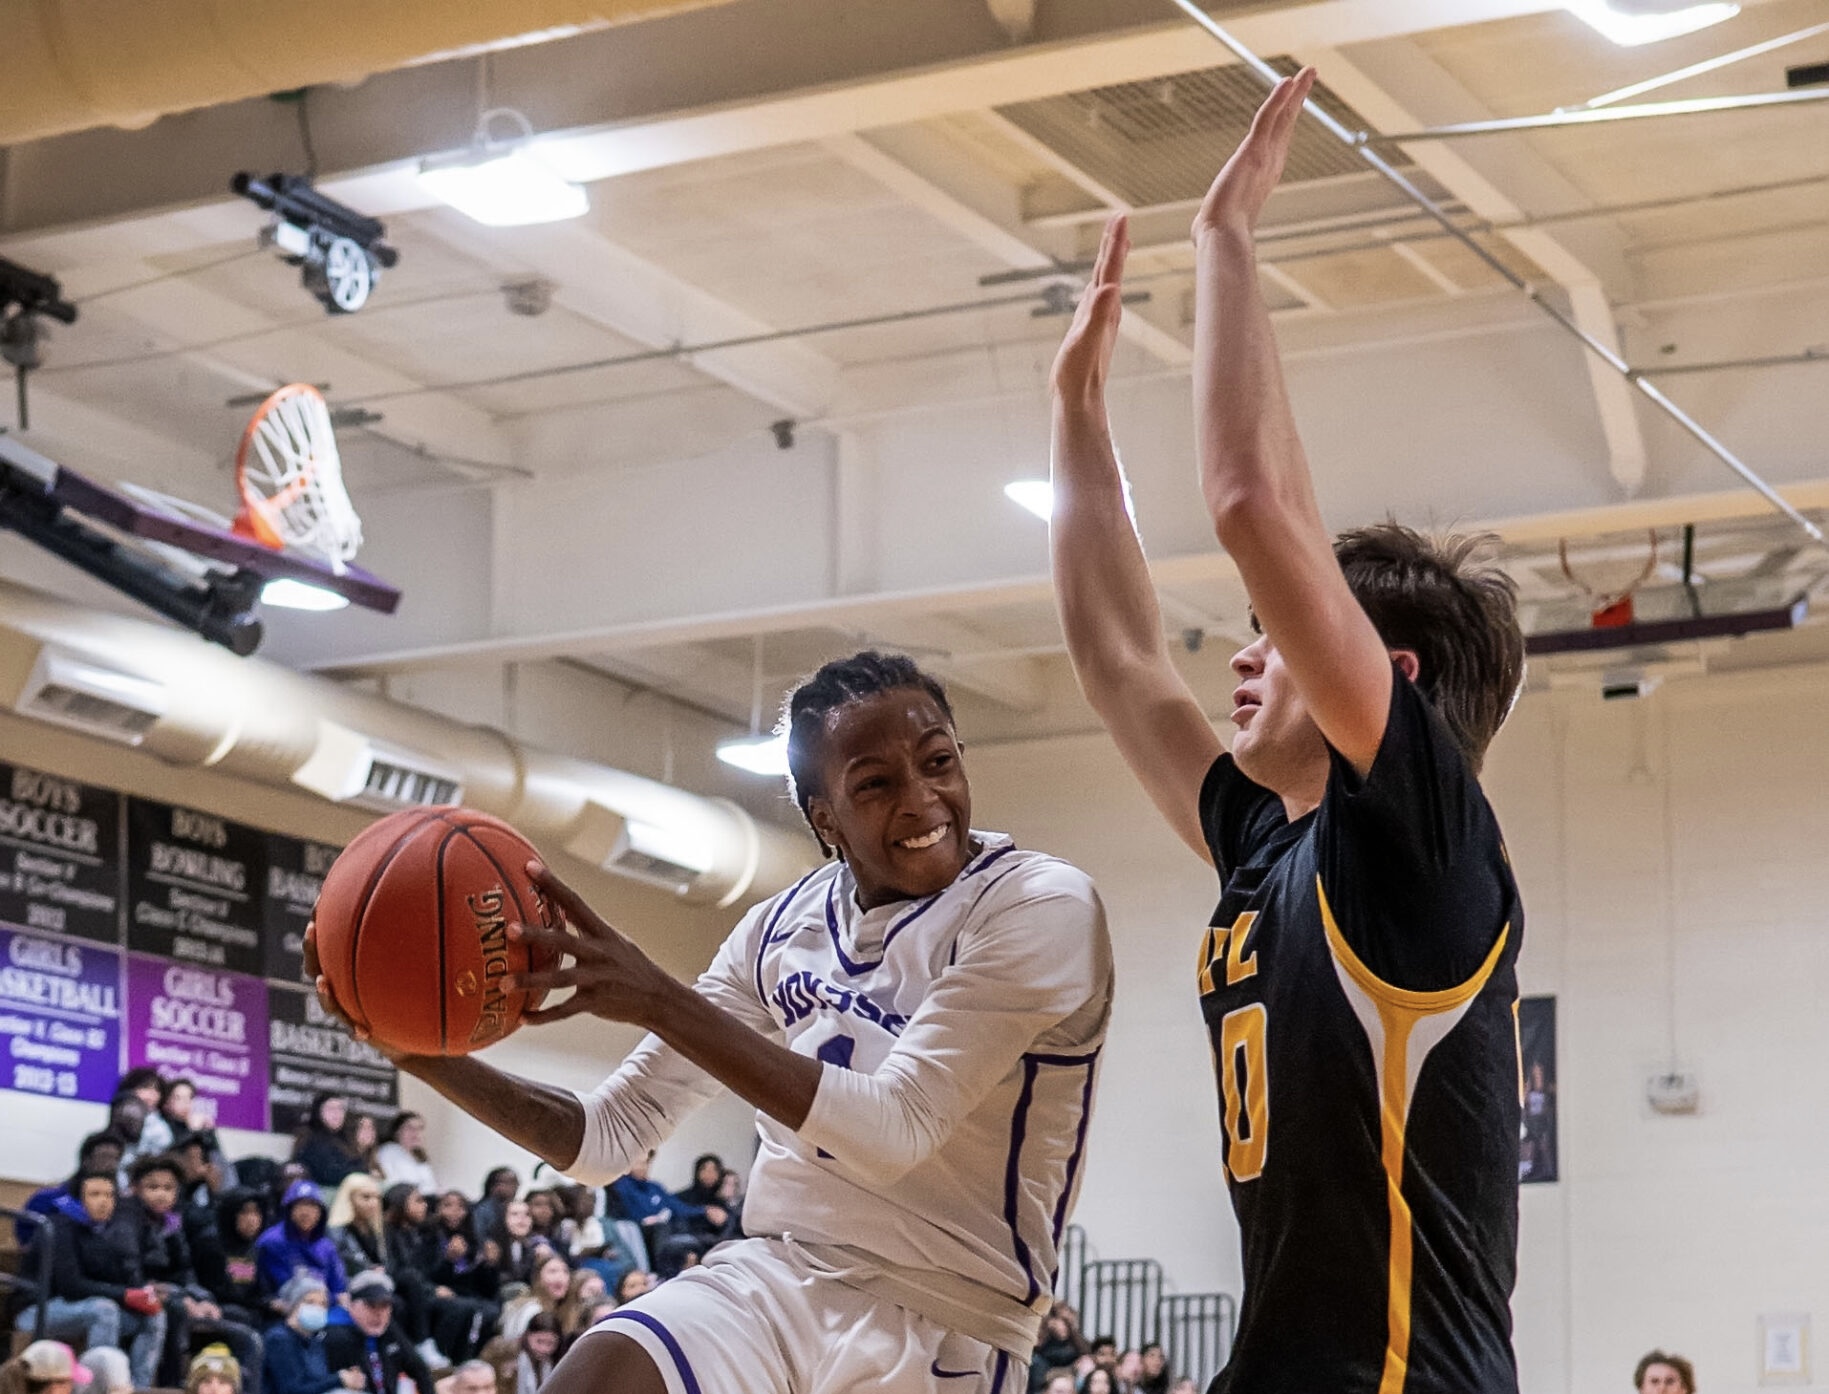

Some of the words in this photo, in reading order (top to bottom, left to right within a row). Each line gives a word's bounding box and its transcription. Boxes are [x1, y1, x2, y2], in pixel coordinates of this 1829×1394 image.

[9, 935, 83, 978] GIRLS
[0, 966, 118, 1018] SKETBALL
[164, 967, 236, 1007] GIRLS
[152, 996, 246, 1042] SOCCER
